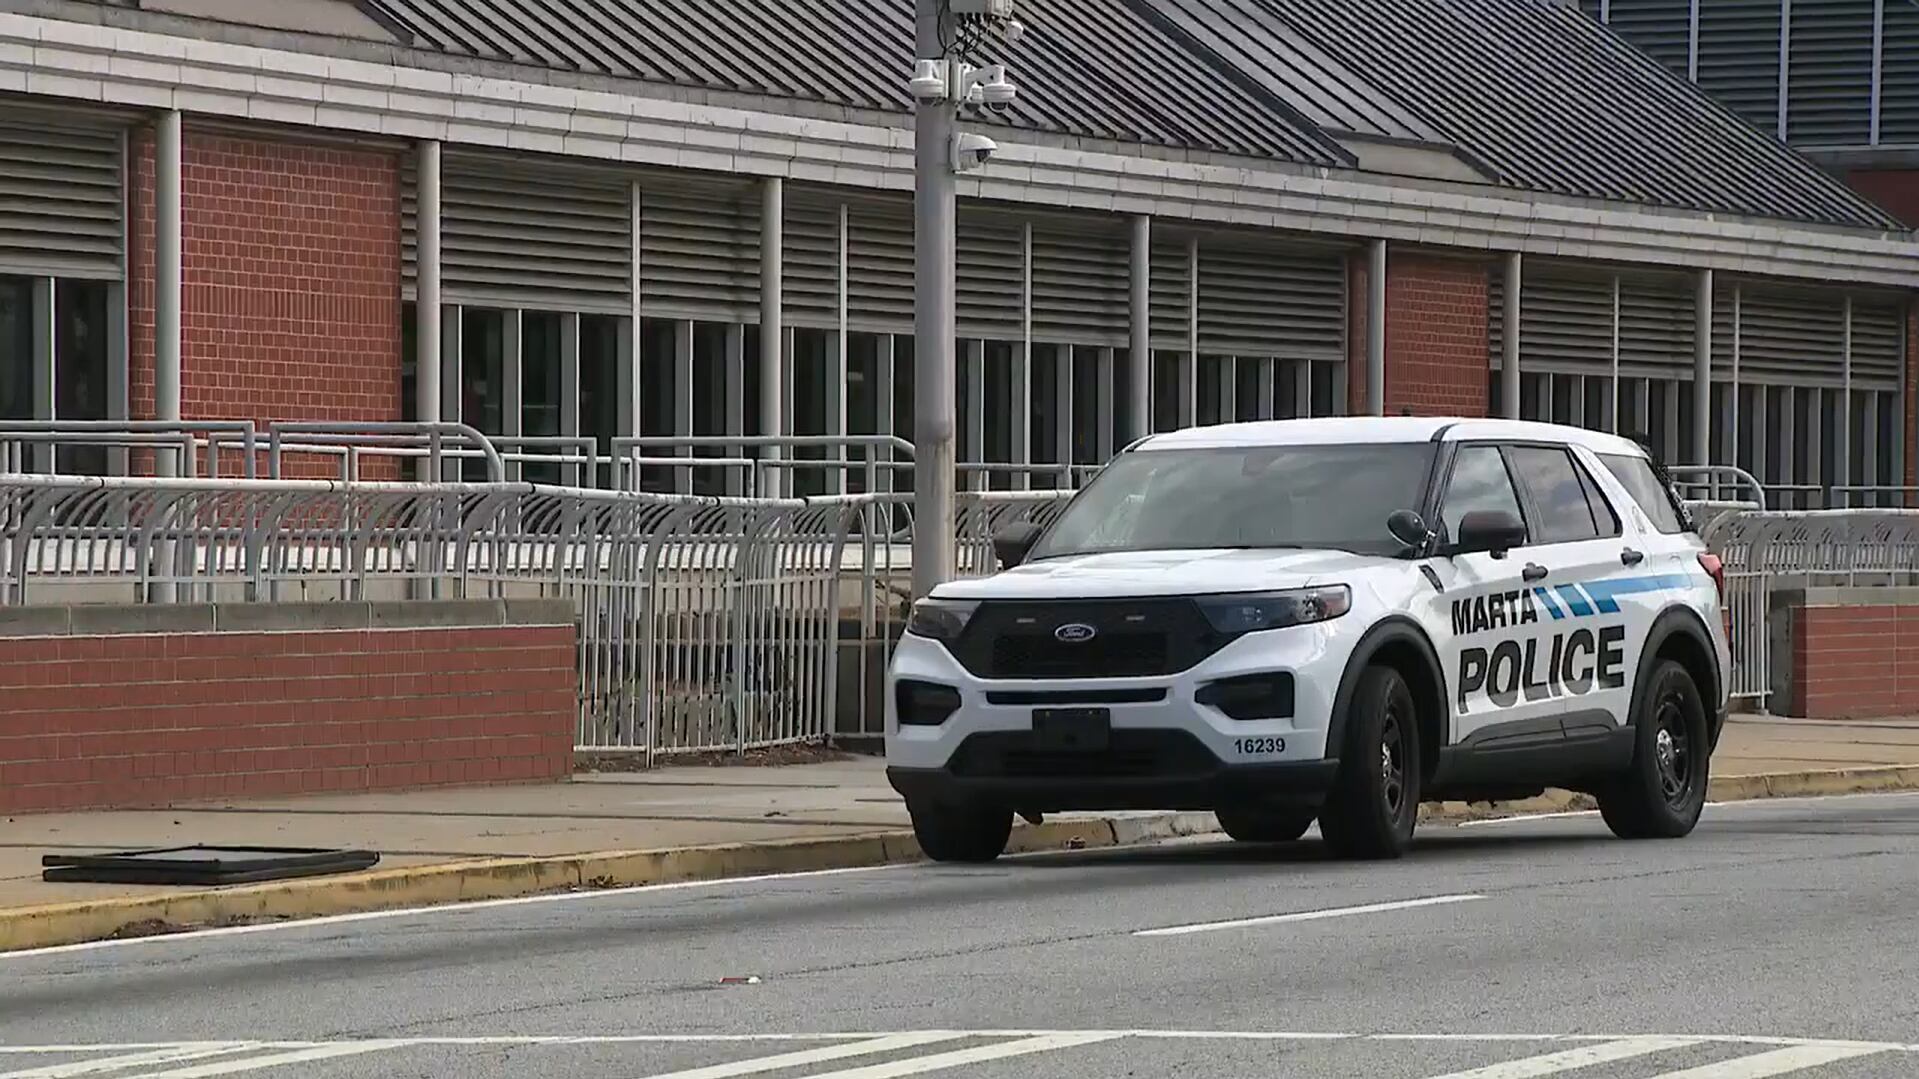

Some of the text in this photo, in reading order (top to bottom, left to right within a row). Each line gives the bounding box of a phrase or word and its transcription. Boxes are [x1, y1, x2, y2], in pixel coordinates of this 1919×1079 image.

[1452, 588, 1538, 635] MARTA
[1458, 625, 1625, 714] POLICE
[1234, 738, 1286, 754] 16239
